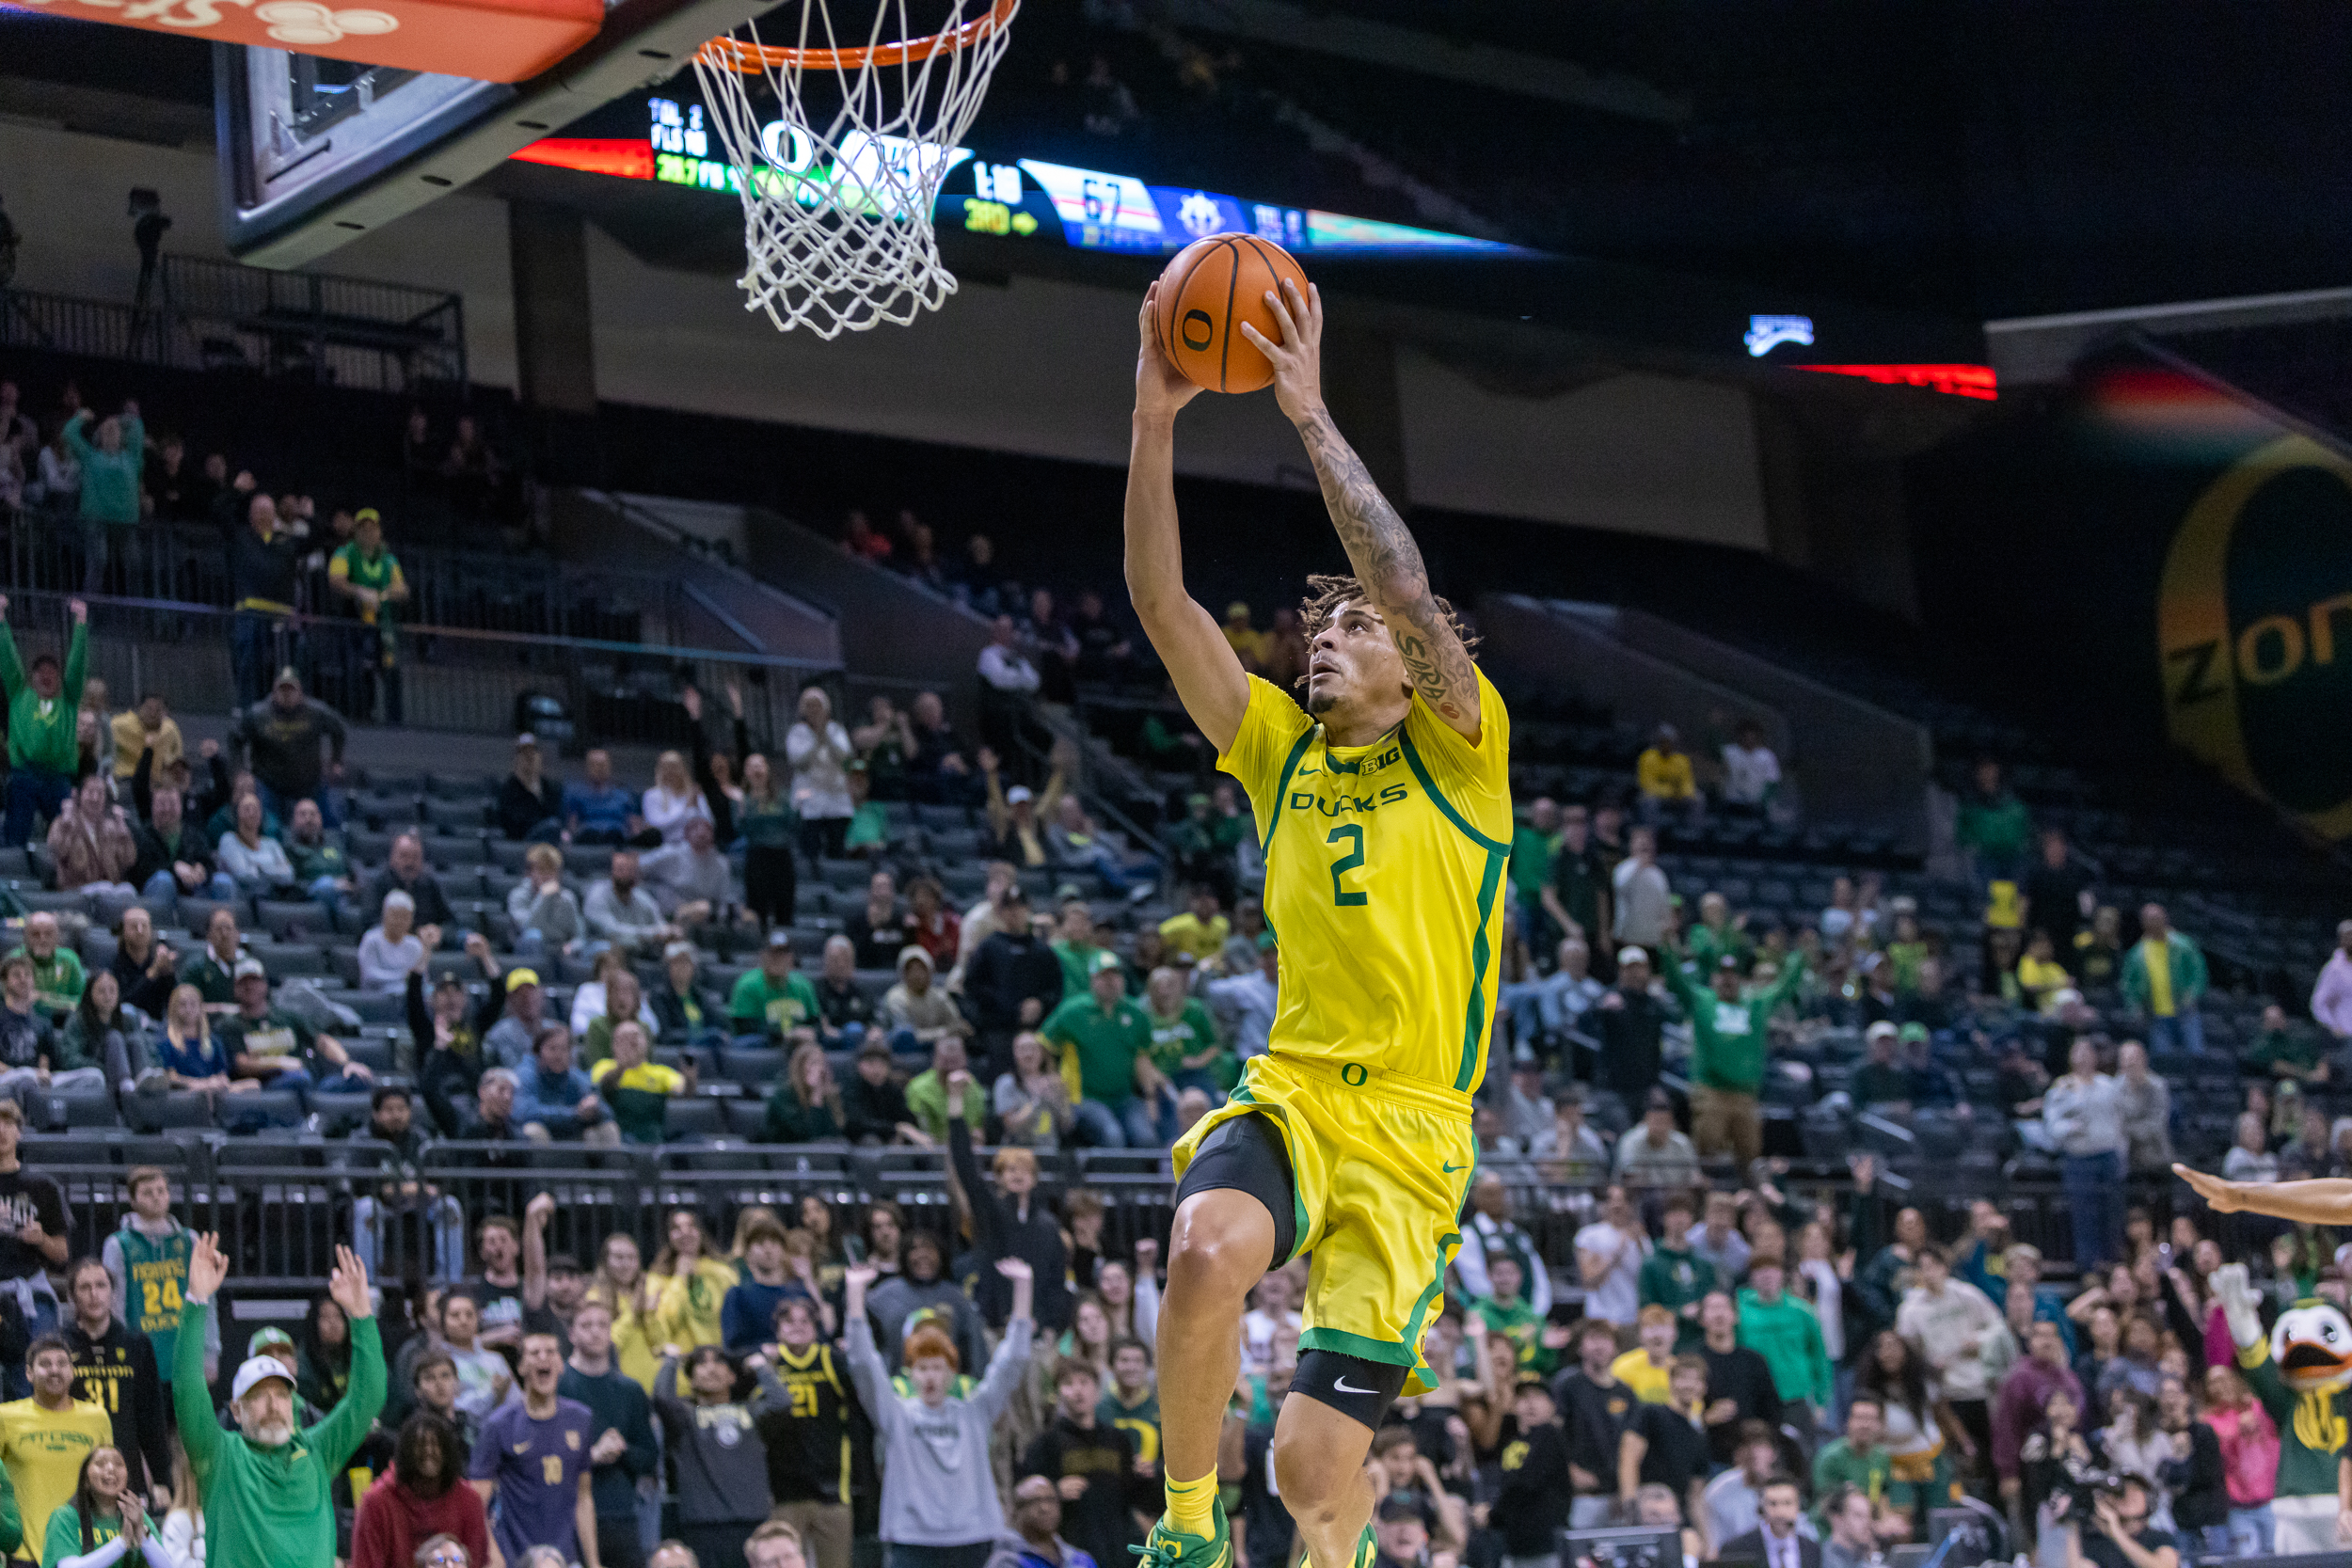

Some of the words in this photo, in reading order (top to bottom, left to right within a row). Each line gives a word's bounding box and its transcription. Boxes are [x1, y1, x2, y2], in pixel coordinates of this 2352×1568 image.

[1183, 309, 1213, 352] O
[1290, 783, 1408, 817] DUCKS
[1326, 823, 1368, 906] 2
[1342, 1062, 1368, 1086] O
[142, 1279, 183, 1314] 24
